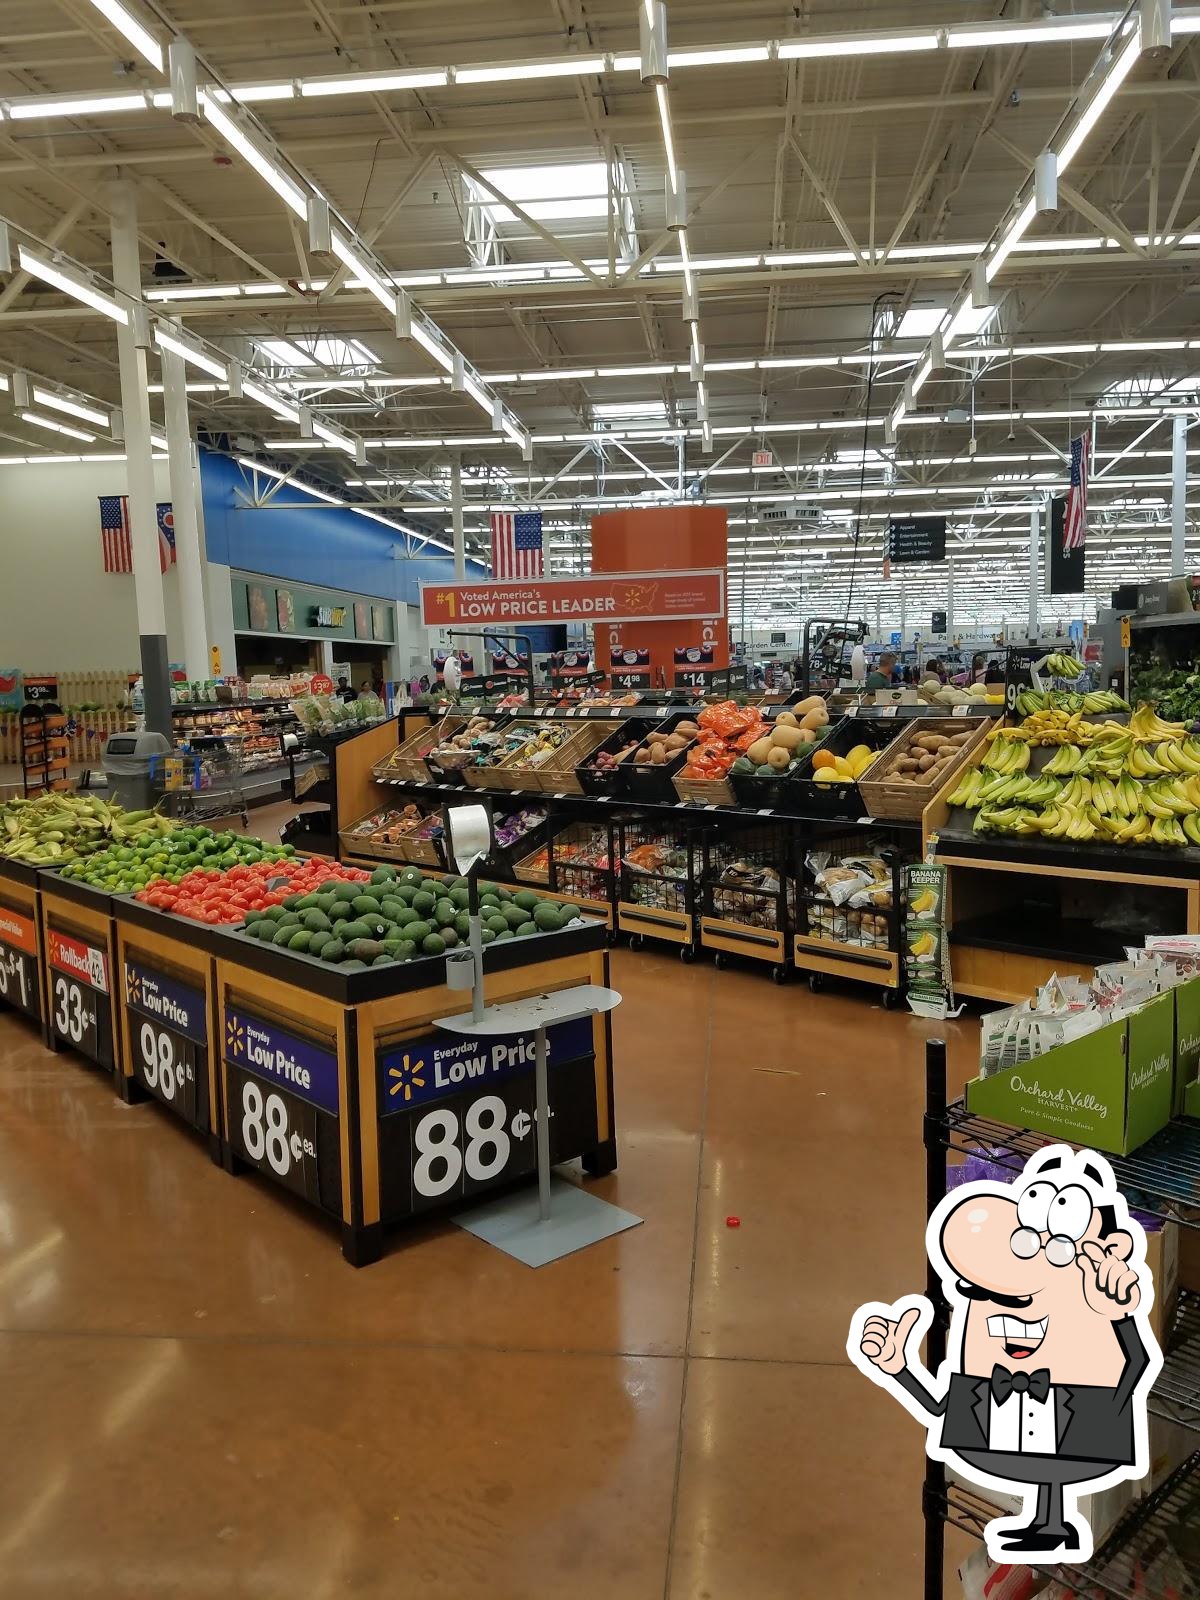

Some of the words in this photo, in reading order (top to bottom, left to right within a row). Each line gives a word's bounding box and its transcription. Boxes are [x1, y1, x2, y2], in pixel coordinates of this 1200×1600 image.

[435, 592, 456, 618] #1
[460, 591, 490, 601] Voted
[491, 589, 541, 600] America's
[460, 602, 496, 617] LOW
[500, 601, 548, 616] PRICE
[552, 597, 616, 614] LEADER
[910, 870, 941, 878] BANANA
[911, 876, 940, 884] KEEPER
[60, 943, 91, 975] Rollback
[142, 985, 162, 1014] Low
[162, 996, 188, 1028] Price
[246, 1025, 271, 1046] Everyday
[246, 1037, 274, 1071] Low
[275, 1050, 311, 1090] Price
[433, 1041, 479, 1061] Everyday
[434, 1055, 488, 1088] Low
[1010, 1075, 1065, 1102] Orchard
[1067, 1089, 1108, 1119] Valley
